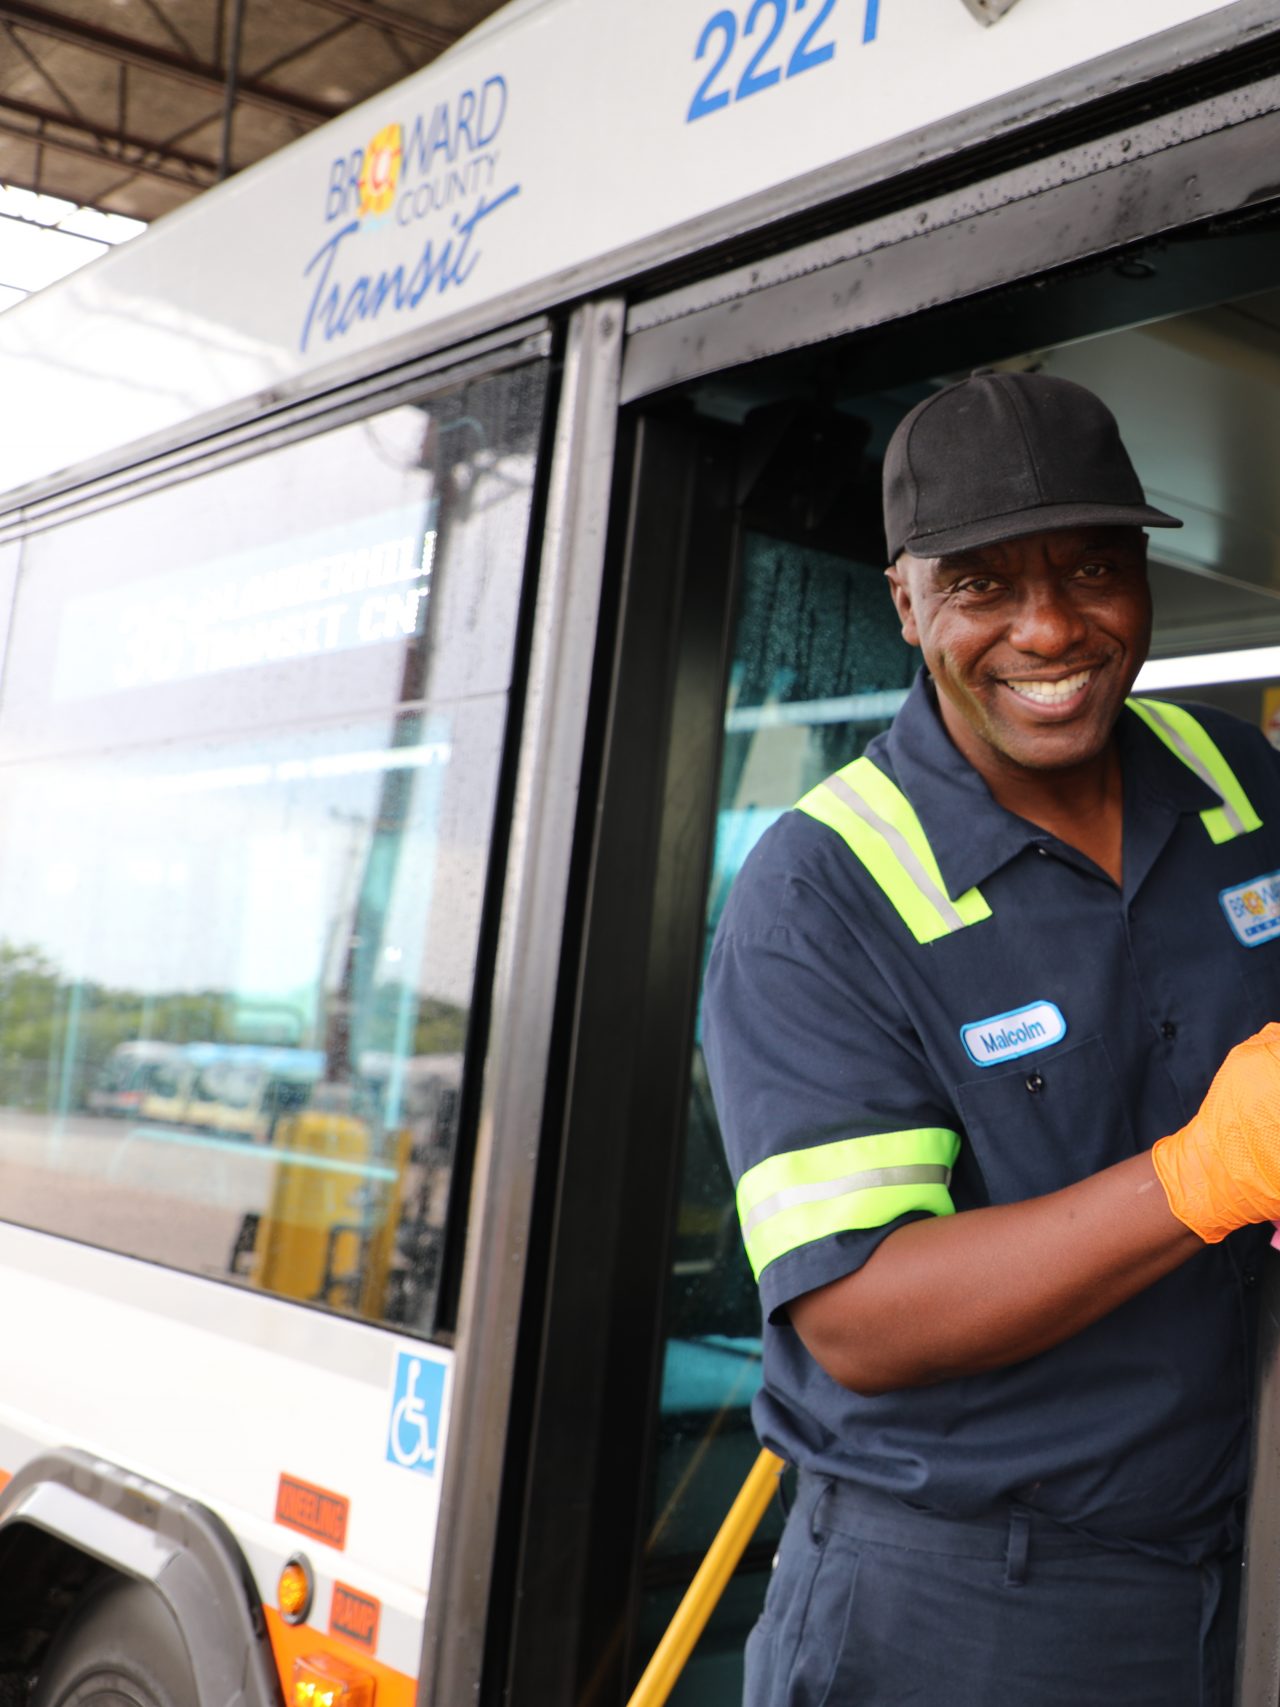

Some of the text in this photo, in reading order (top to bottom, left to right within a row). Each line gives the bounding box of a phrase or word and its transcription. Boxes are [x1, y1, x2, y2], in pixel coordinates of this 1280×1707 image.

[326, 73, 507, 223] BROWARD
[396, 151, 500, 226] COUNTY
[301, 183, 521, 353] Transit
[357, 586, 429, 641] CN
[980, 1021, 1047, 1054] Malcolm
